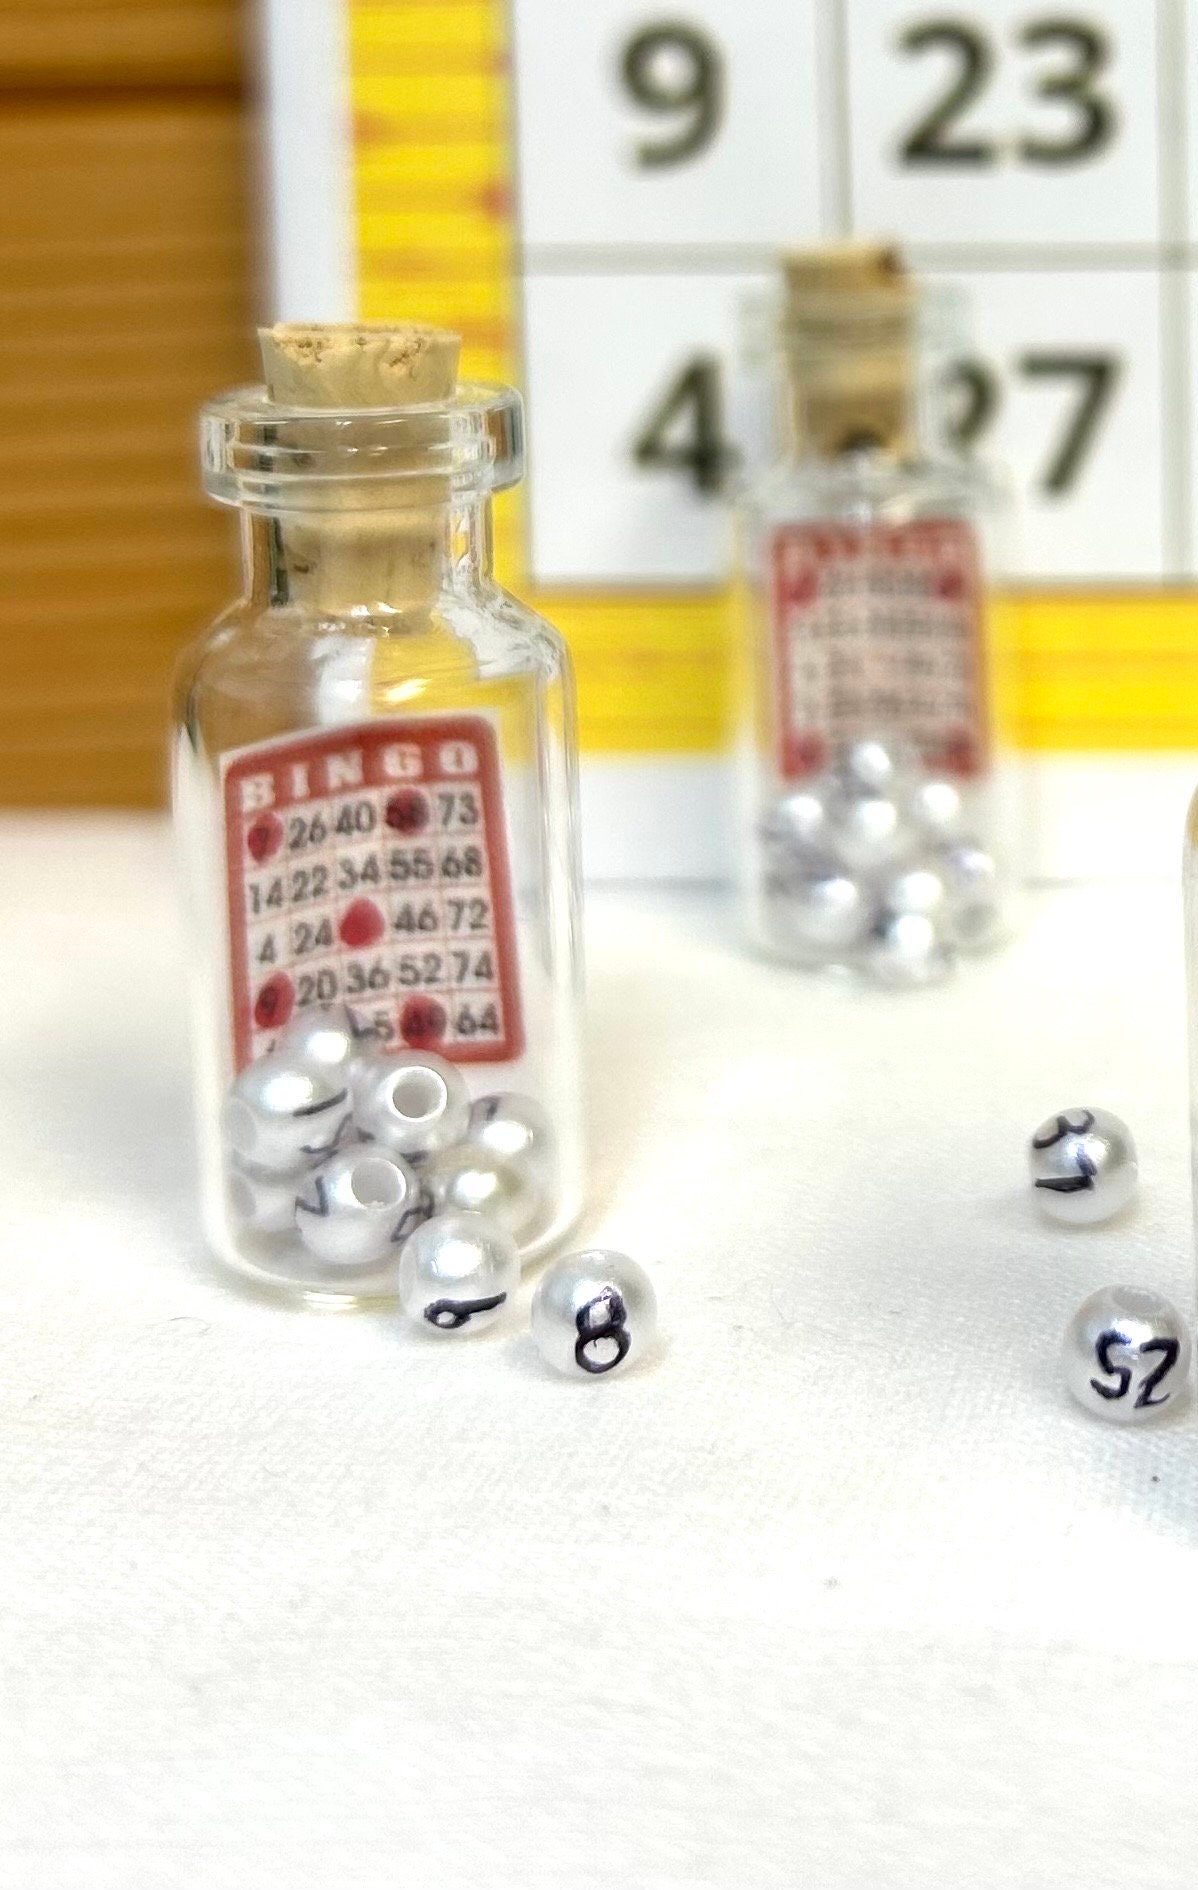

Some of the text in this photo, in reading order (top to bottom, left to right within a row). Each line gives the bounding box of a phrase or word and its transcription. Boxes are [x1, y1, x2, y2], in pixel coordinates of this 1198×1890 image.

[616, 15, 727, 170] 9
[893, 15, 1118, 169] 23
[630, 350, 733, 498] 4
[288, 810, 328, 851] 26
[335, 800, 377, 837] 40
[437, 791, 480, 827] 73
[249, 845, 484, 915] 14 22 34 55 68
[257, 898, 489, 965] 4 24 46 72
[297, 967, 339, 1008] 20
[346, 956, 391, 994] 36
[398, 952, 443, 986] 52
[450, 950, 495, 983] 74
[455, 1003, 500, 1036] 64
[574, 1285, 632, 1374] 8
